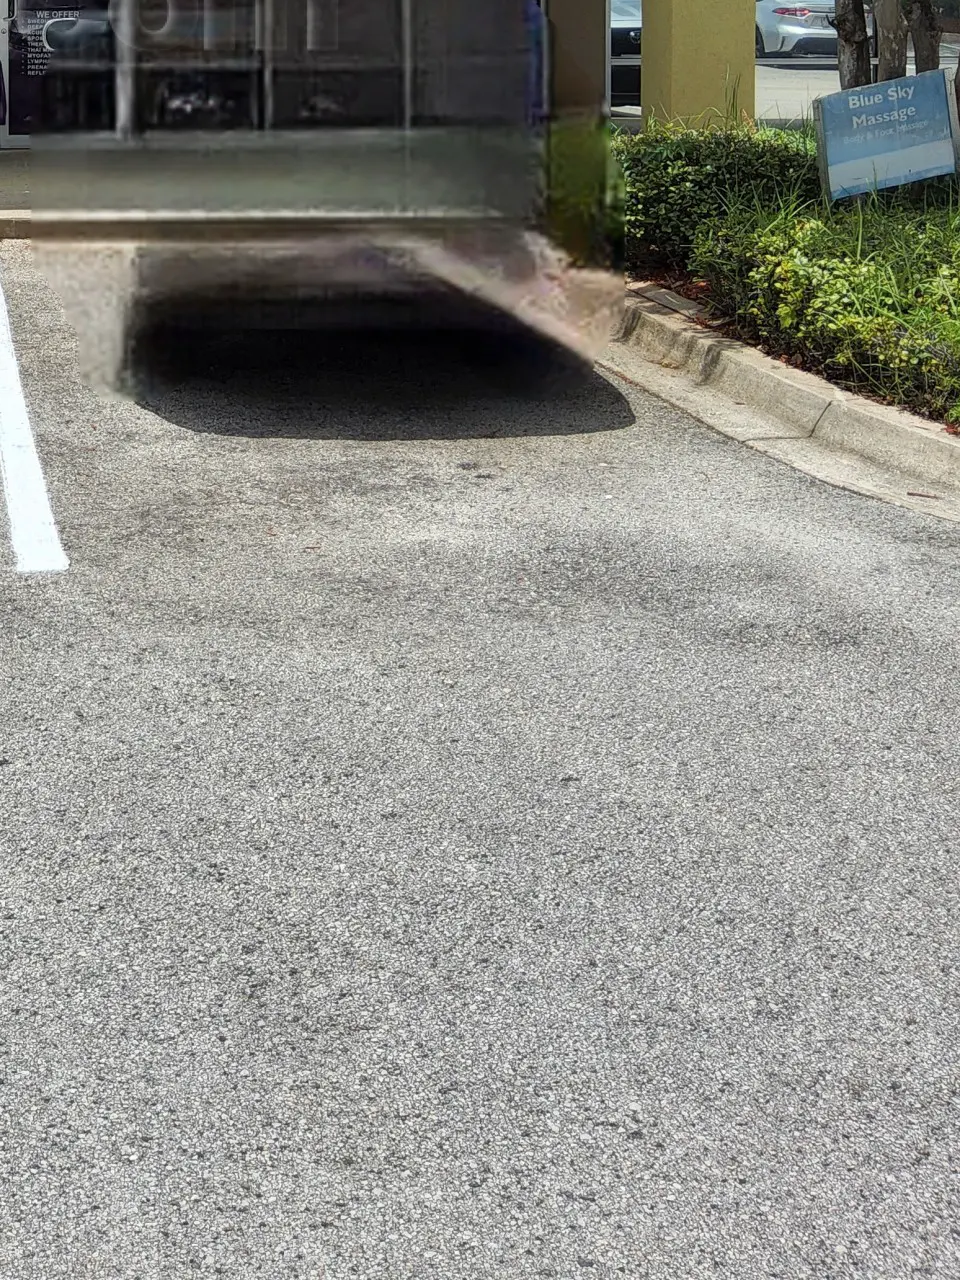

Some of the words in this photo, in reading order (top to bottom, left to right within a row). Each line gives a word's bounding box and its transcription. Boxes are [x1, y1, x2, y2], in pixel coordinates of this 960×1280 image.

[36, 10, 50, 18] WE
[52, 10, 80, 18] OFFER
[848, 93, 883, 109] Blue
[887, 86, 915, 101] Sky
[852, 106, 916, 129] Massage
